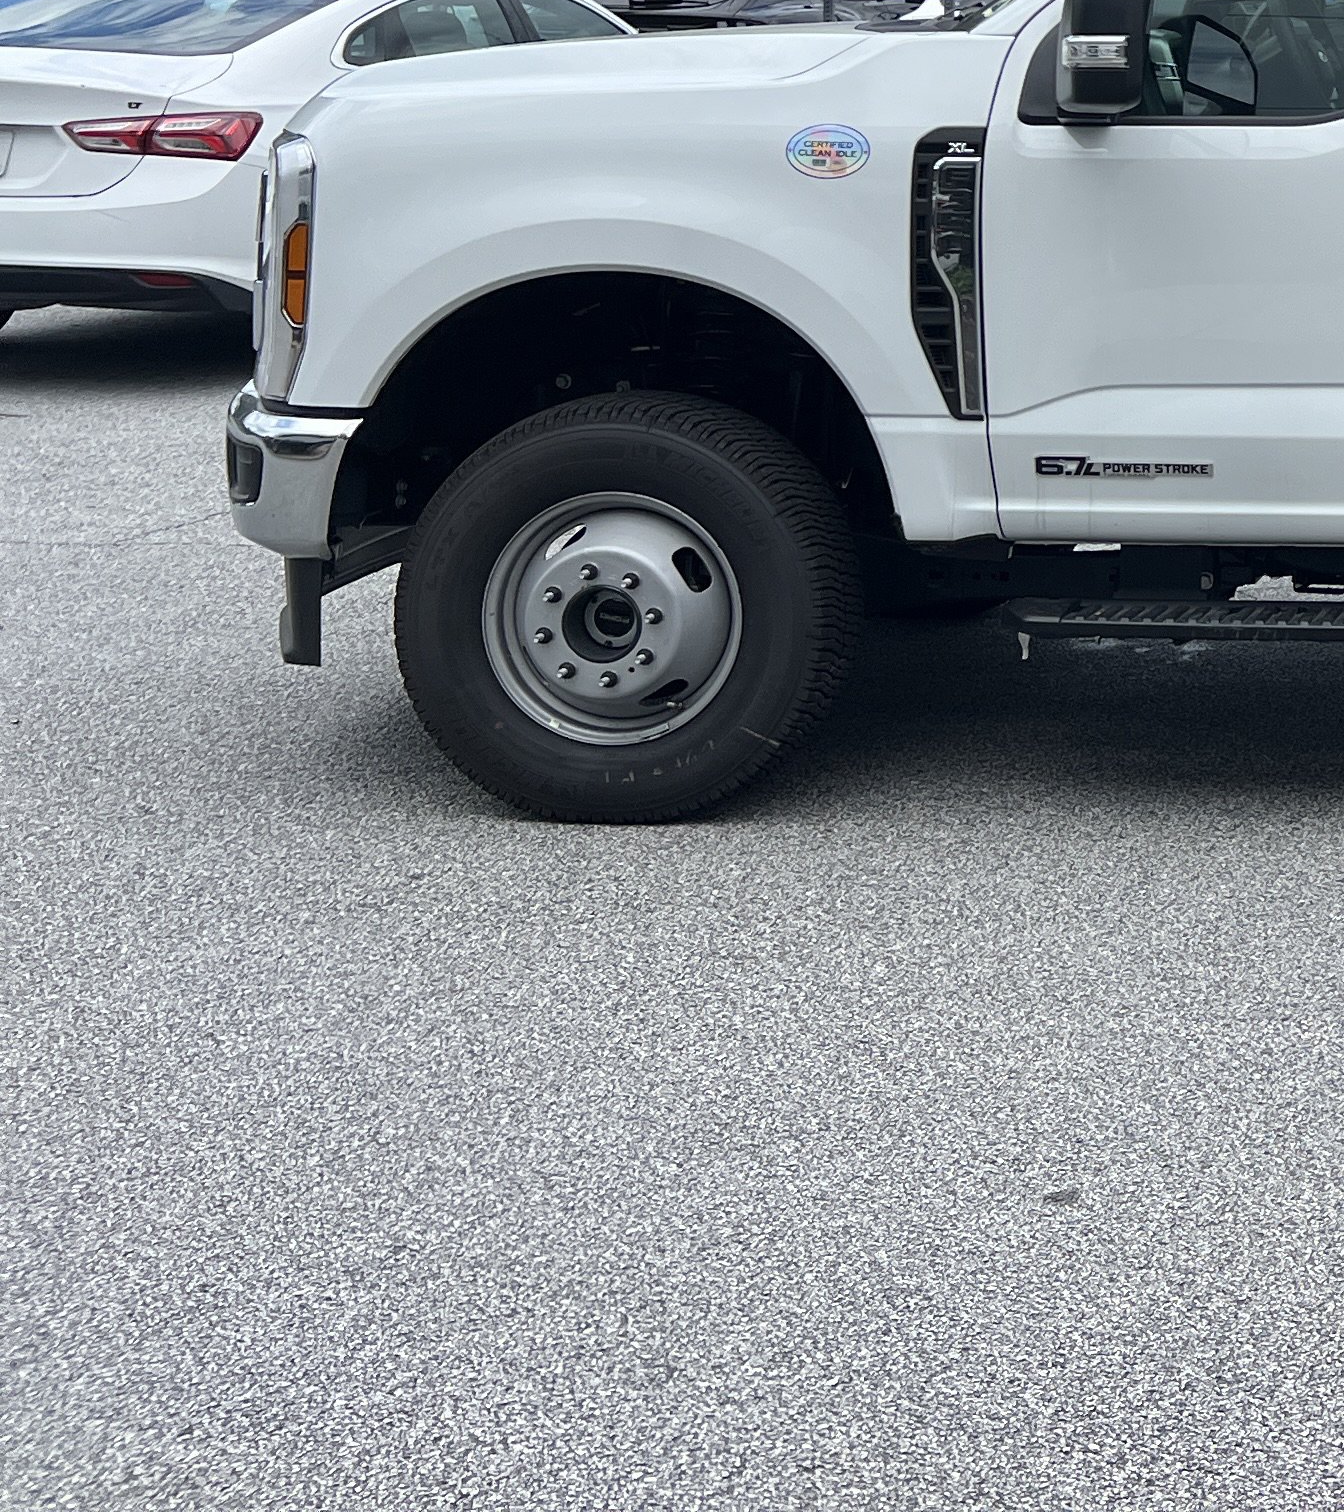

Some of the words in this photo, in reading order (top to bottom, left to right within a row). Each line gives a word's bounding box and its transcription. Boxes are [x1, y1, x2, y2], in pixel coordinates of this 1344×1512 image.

[804, 141, 854, 149] CERTIFIED
[948, 142, 975, 153] XL
[798, 149, 831, 157] CLEAN
[1035, 456, 1100, 476] 6.7L
[1102, 463, 1150, 473] POWER
[1154, 463, 1209, 474] STROKE
